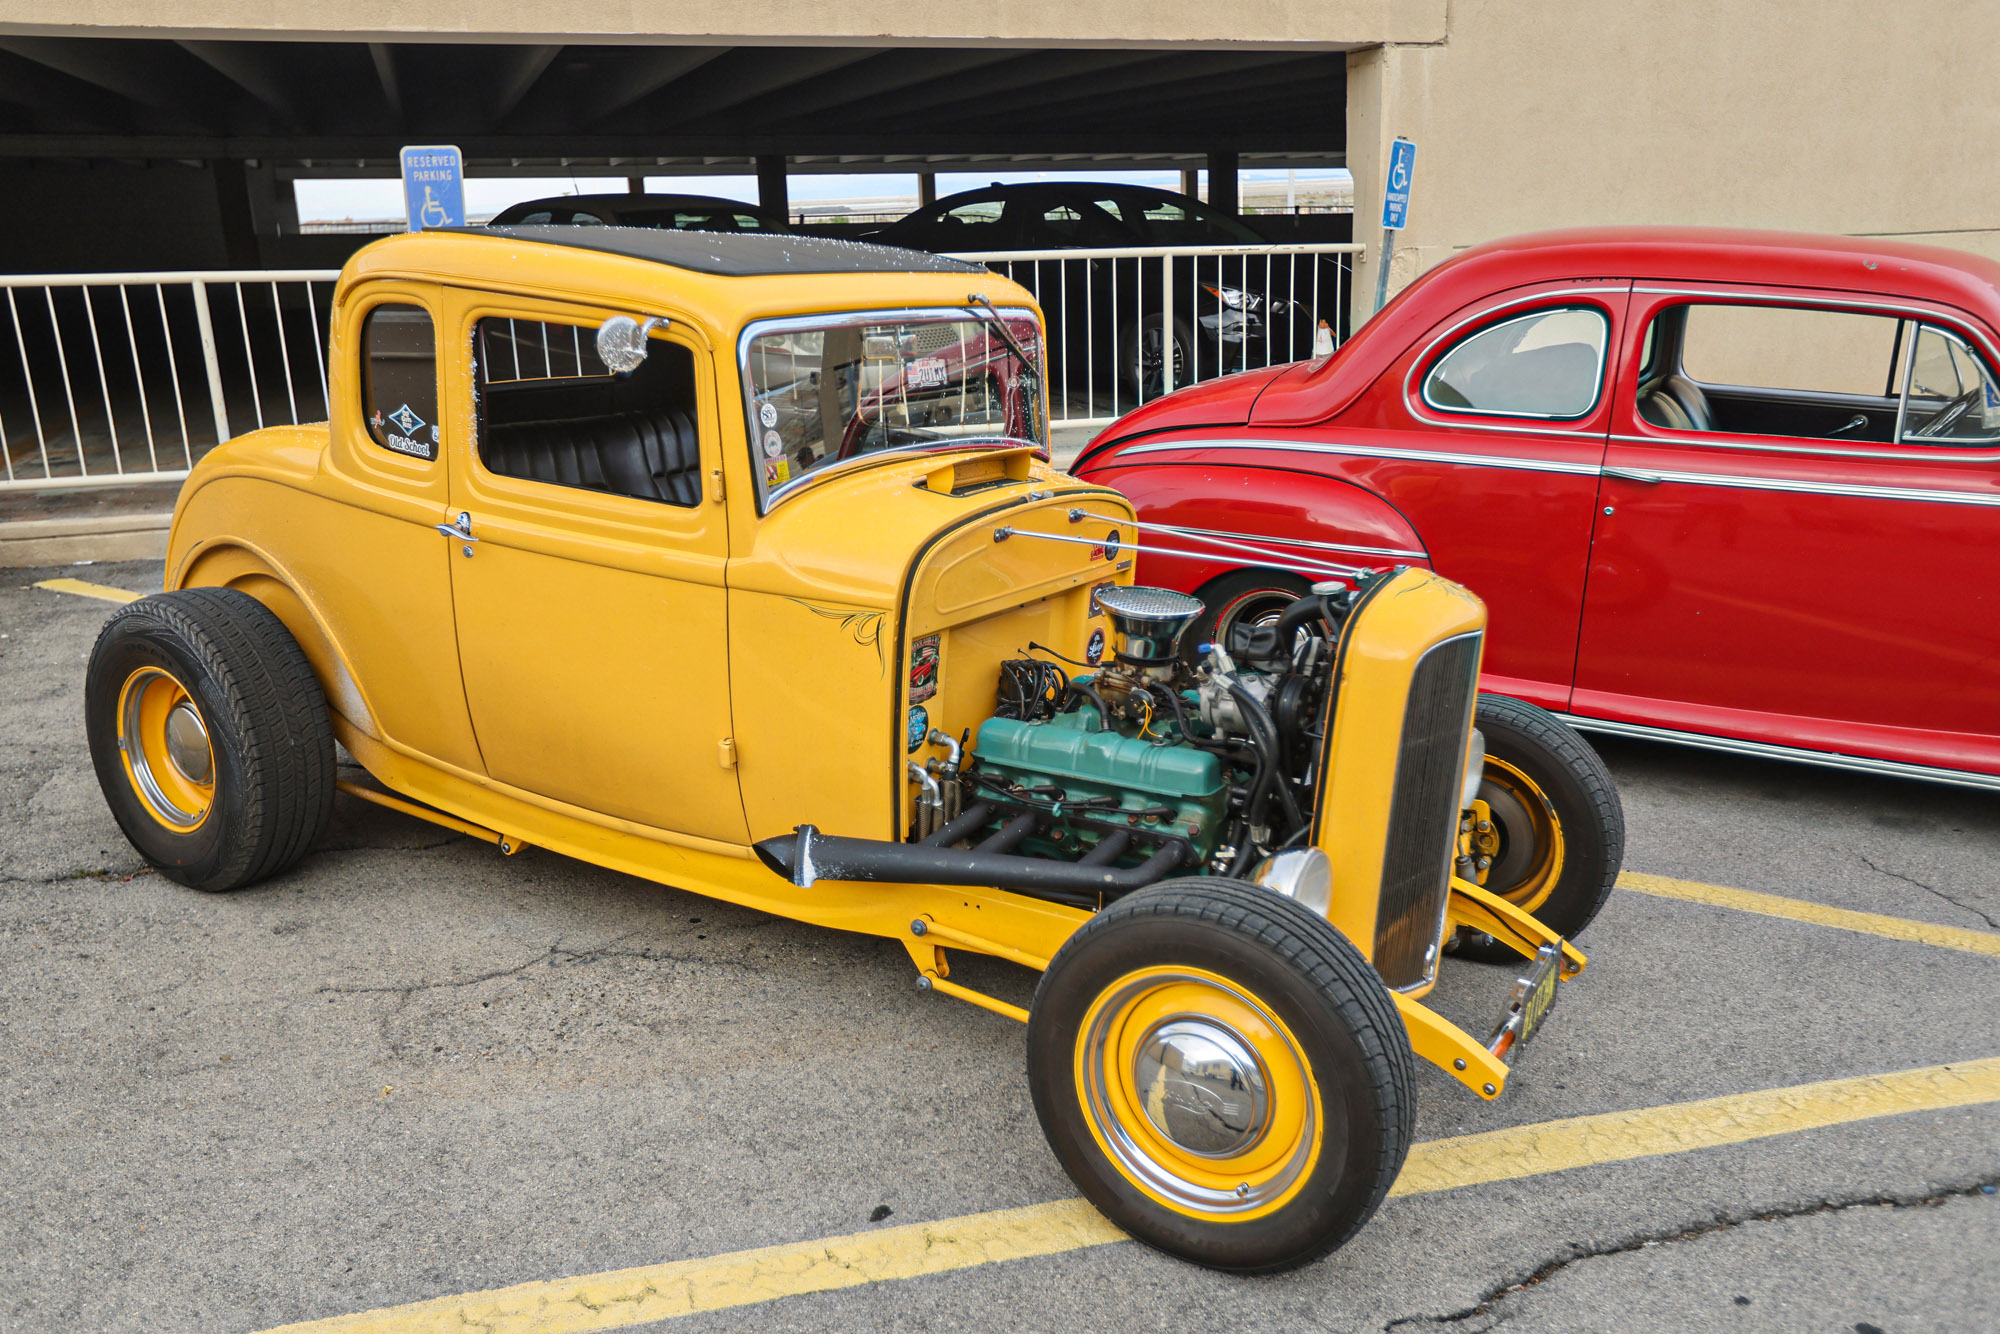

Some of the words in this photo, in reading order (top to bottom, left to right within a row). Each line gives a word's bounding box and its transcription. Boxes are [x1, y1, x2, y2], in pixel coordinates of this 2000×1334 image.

[407, 155, 456, 168] RESERVED
[413, 169, 453, 182] PARKING
[388, 434, 403, 449] Old
[405, 438, 430, 456] School
